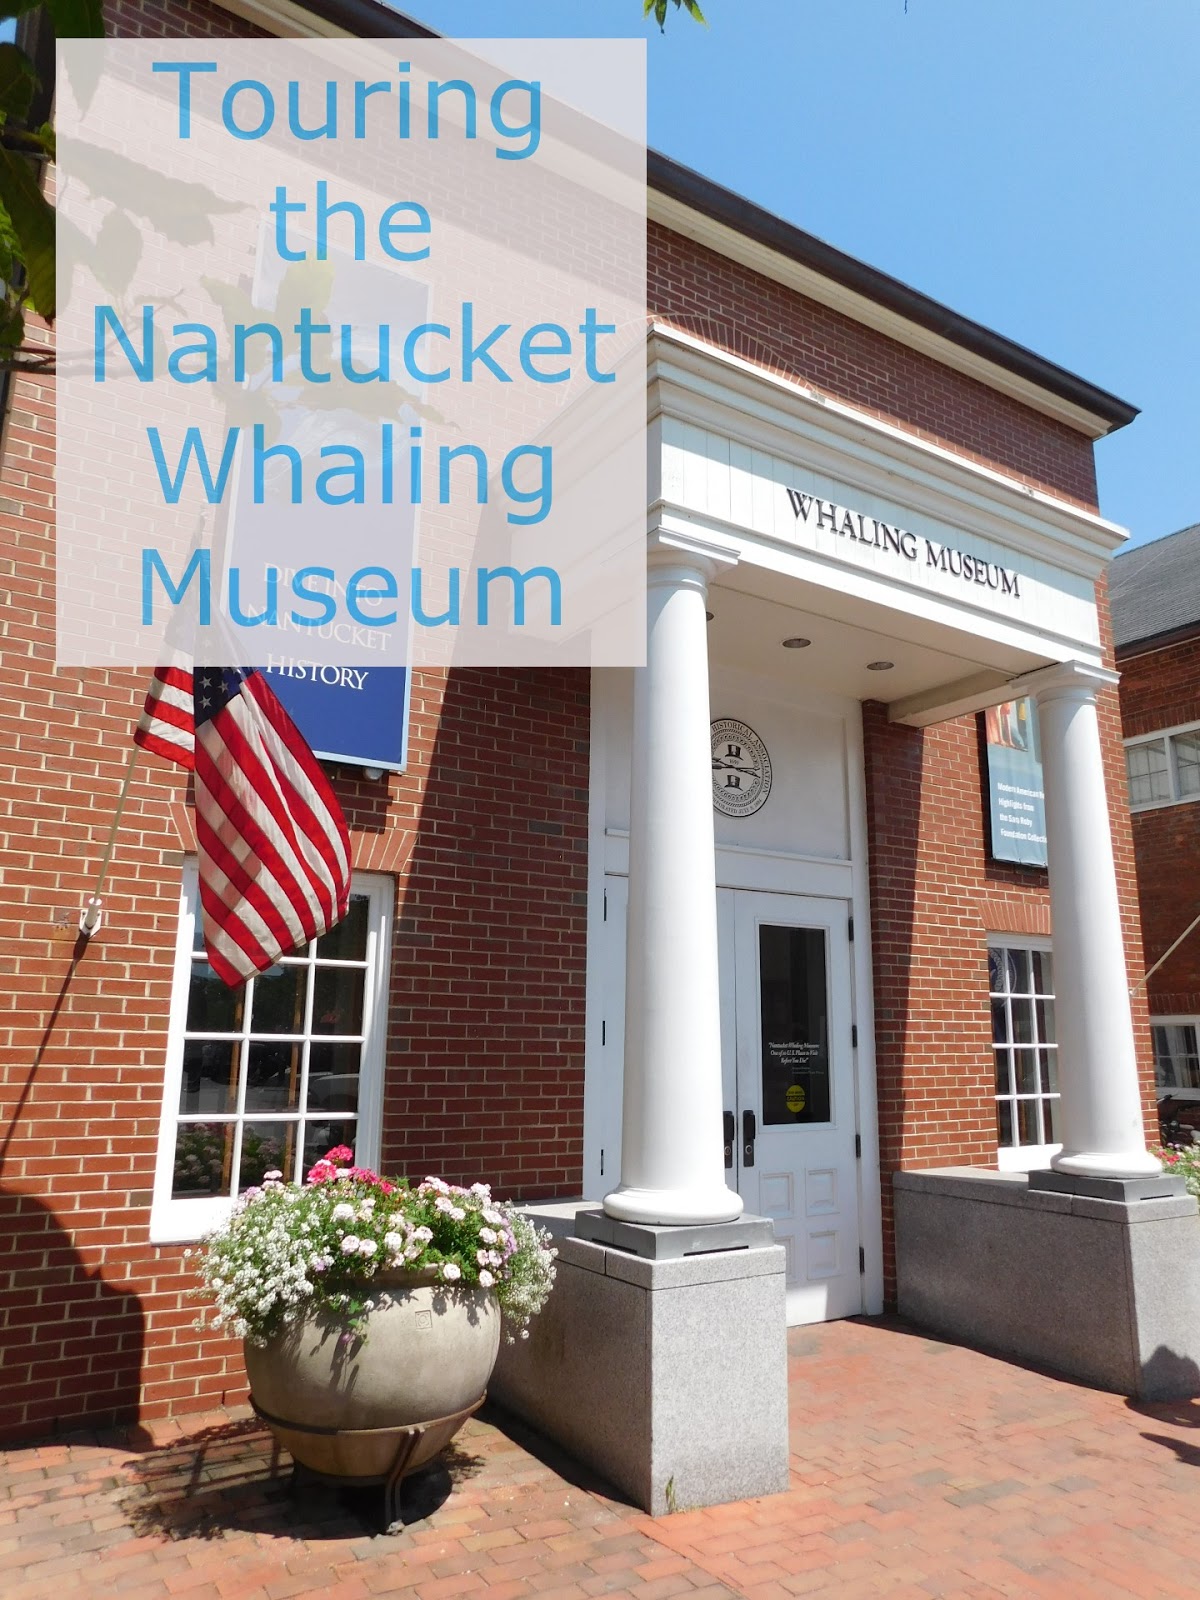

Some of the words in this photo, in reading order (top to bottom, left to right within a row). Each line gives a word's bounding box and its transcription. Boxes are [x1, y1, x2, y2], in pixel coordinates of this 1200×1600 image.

[787, 488, 917, 561] WHALING
[925, 540, 1021, 599] MUSEUM
[263, 562, 320, 593] DIVE
[325, 578, 383, 607] INTO
[246, 603, 392, 651] NANTUCKET
[266, 653, 369, 690] HISTORY
[997, 782, 1016, 793] Modern
[1017, 787, 1038, 798] American
[998, 797, 1023, 810] Highlights
[1023, 802, 1034, 812] from
[1000, 813, 1008, 821] the
[1009, 815, 1019, 824] Sara
[1001, 828, 1027, 840] Foundation
[1027, 833, 1047, 843] Collecti
